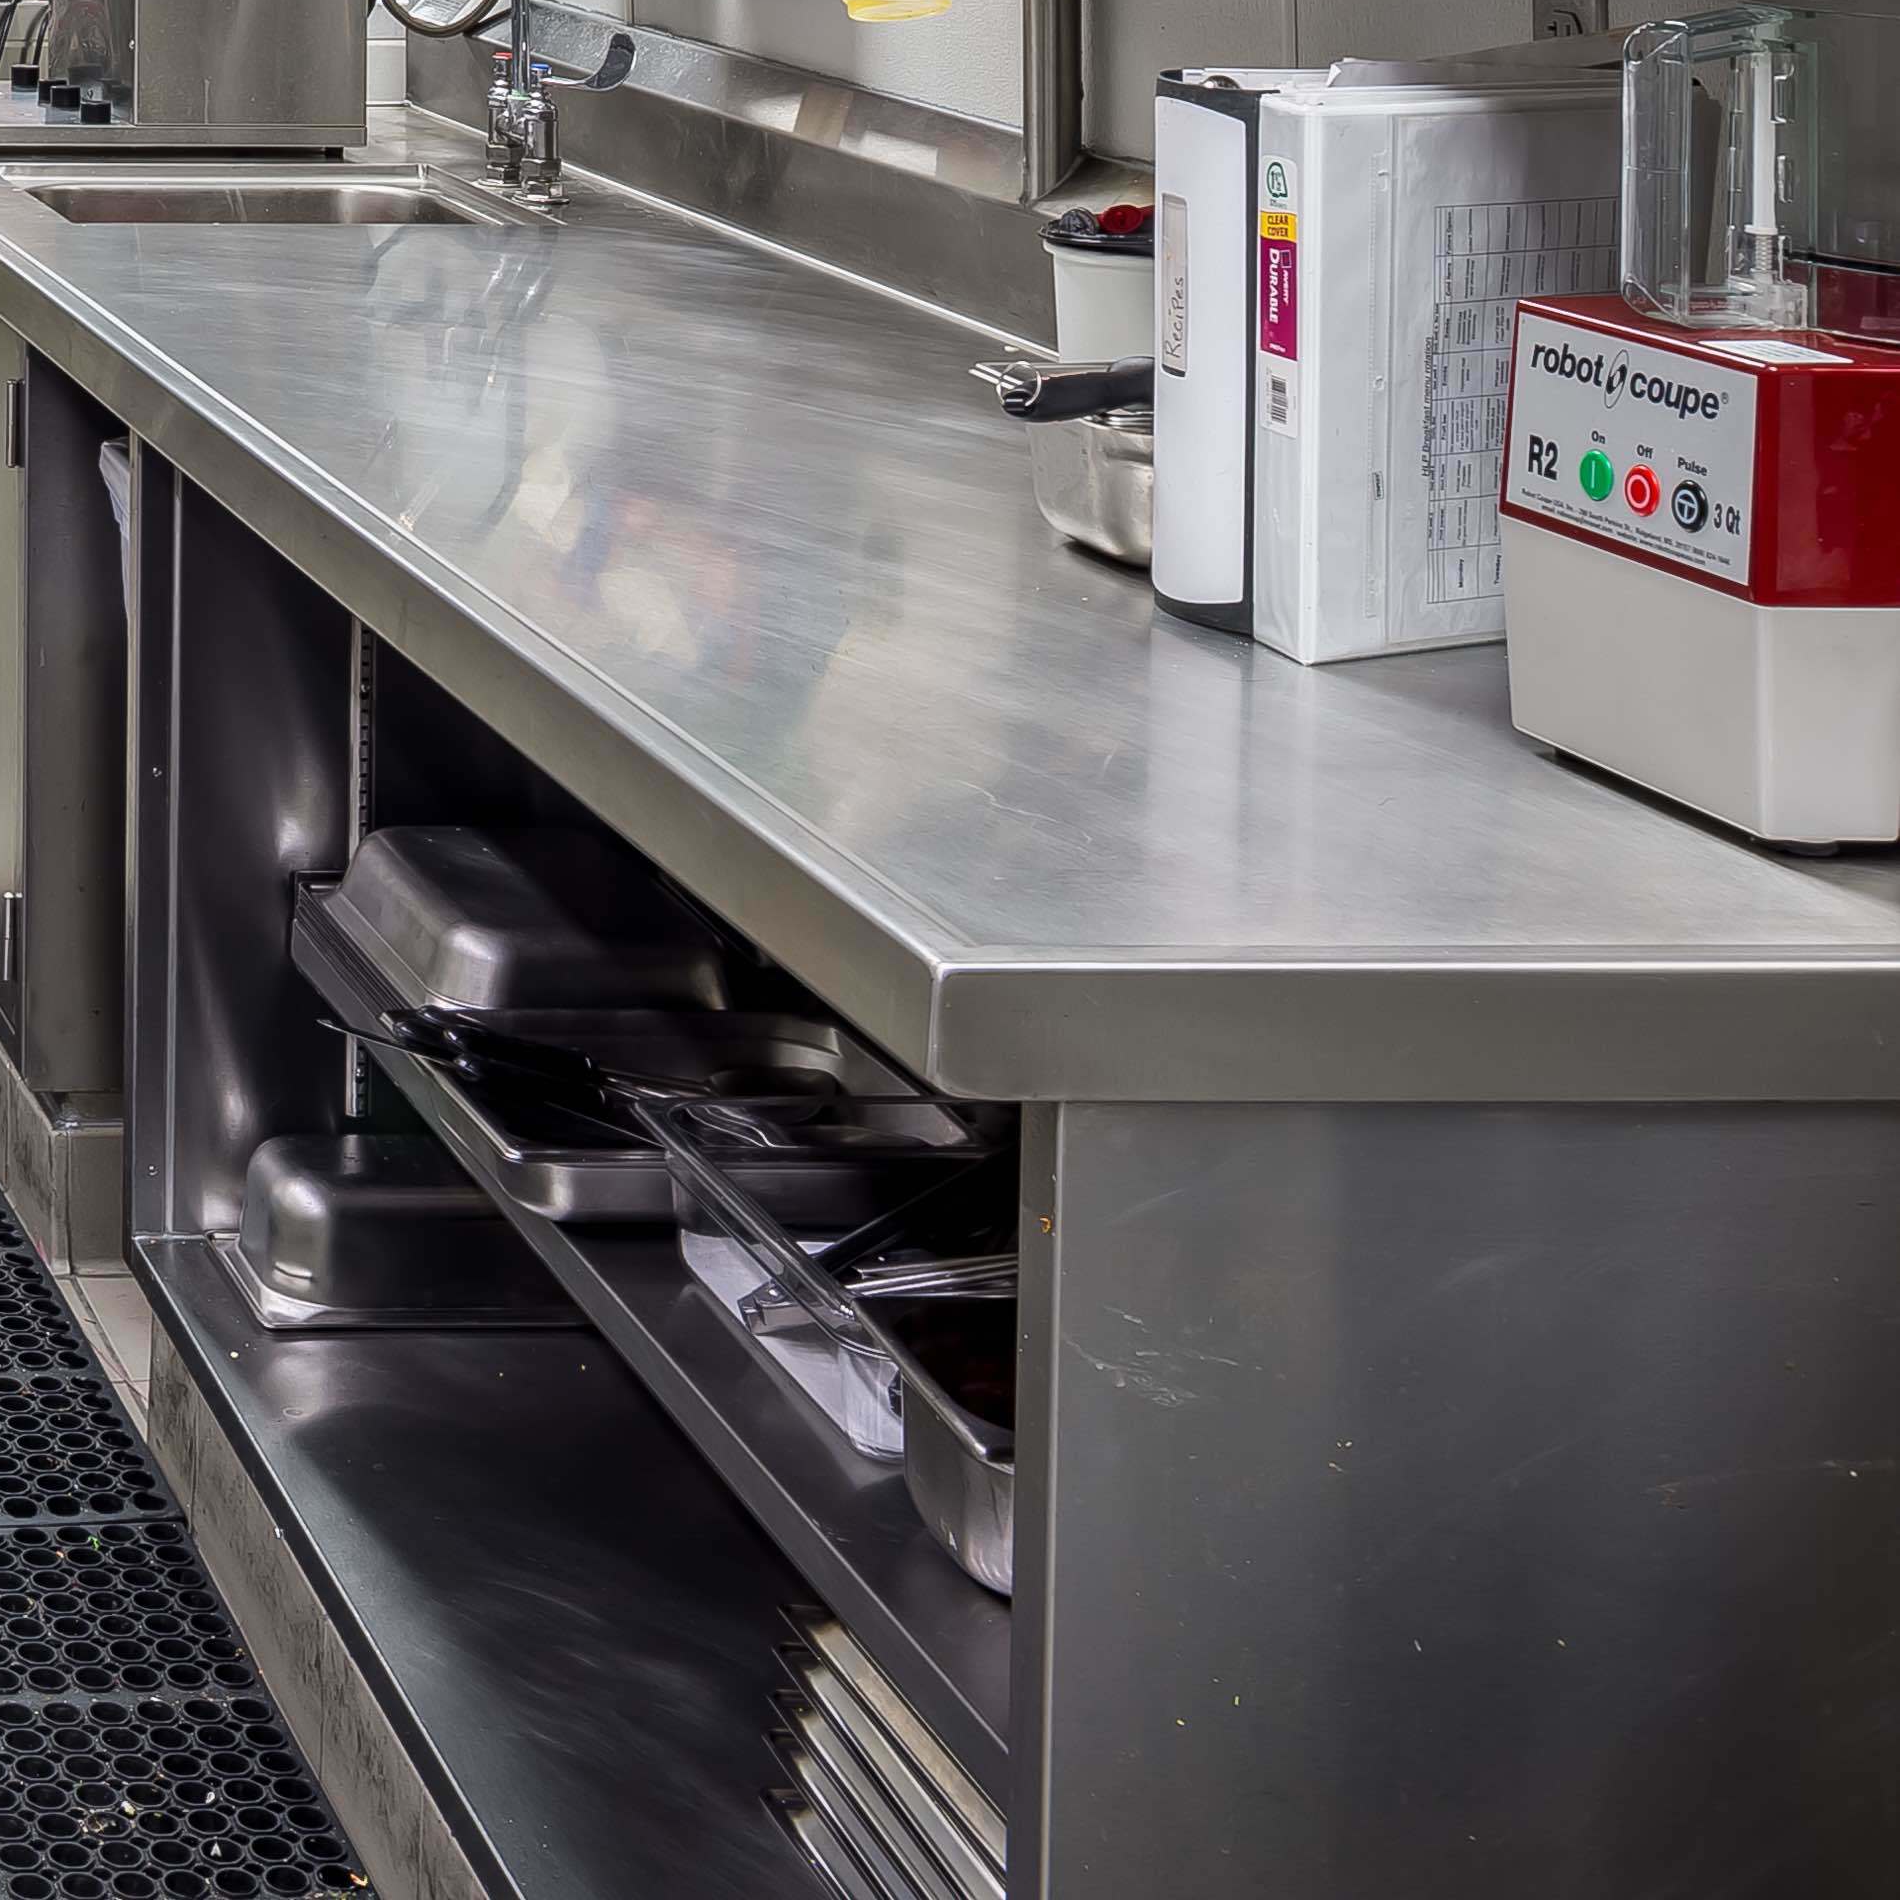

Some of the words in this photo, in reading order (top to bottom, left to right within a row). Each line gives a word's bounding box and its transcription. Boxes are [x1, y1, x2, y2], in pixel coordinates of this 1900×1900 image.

[1267, 214, 1289, 226] CLEAR
[1267, 227, 1289, 238] COVER
[1269, 247, 1280, 324] DURABLE
[1423, 336, 1433, 374] rotation
[1422, 376, 1432, 404] menu
[1530, 343, 1605, 388] robot
[1630, 372, 1720, 420] coupe
[1422, 407, 1431, 453] Breakfast
[1591, 430, 1606, 445] On
[1528, 433, 1559, 481] R2
[1636, 444, 1654, 460] Off
[1676, 456, 1708, 477] Pulse
[1713, 503, 1723, 529] 3
[1725, 505, 1742, 536] Qt
[1457, 558, 1465, 588] Monday
[1493, 554, 1502, 585] Tuesday
